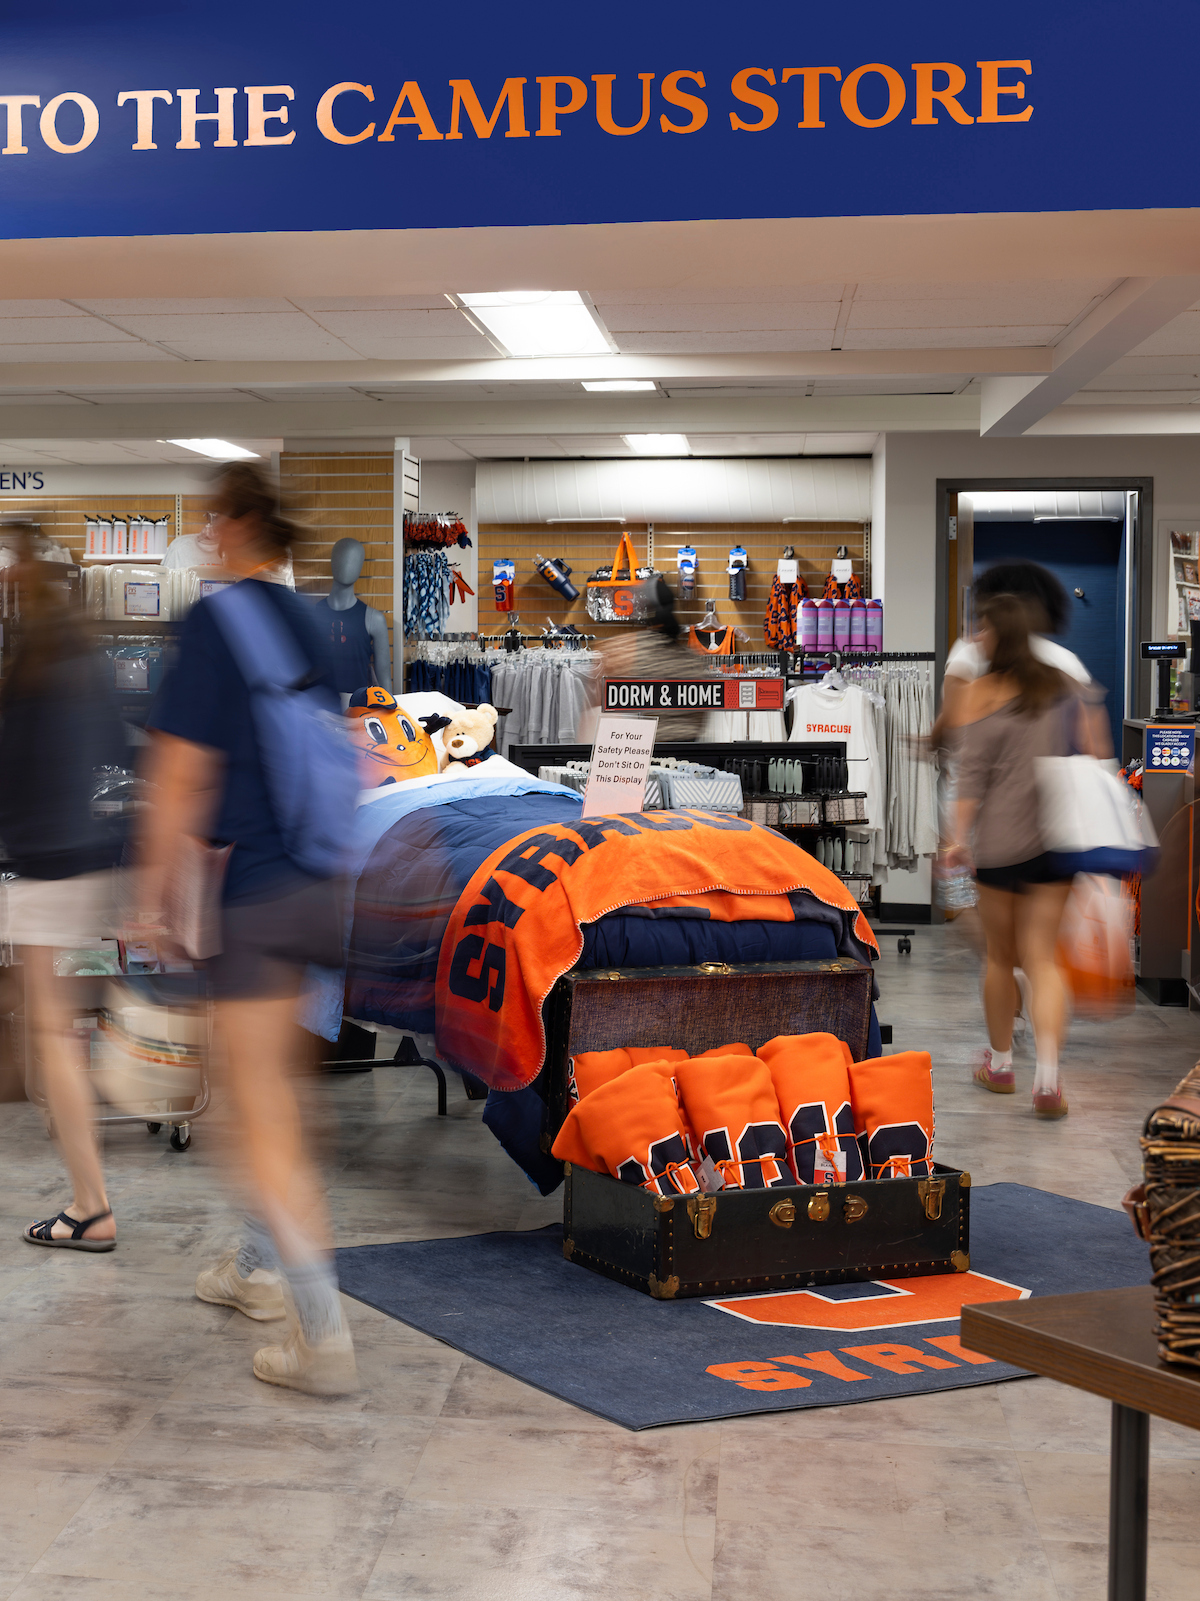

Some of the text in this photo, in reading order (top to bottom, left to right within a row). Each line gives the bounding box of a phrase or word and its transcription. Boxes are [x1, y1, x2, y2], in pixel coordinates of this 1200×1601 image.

[117, 86, 297, 151] THE
[316, 69, 709, 145] CAMPUS
[728, 60, 1035, 132] STORE
[544, 567, 558, 582] S
[494, 585, 507, 603] S
[614, 590, 634, 616] S
[373, 690, 386, 703] S
[608, 684, 722, 707] DORM & HOME
[610, 731, 643, 741] For Your
[597, 745, 650, 756] Safety Please
[598, 760, 645, 769] Don't Sit On
[595, 774, 643, 785] This Display
[449, 809, 793, 1013] SYRACU
[824, 1172, 835, 1184] S
